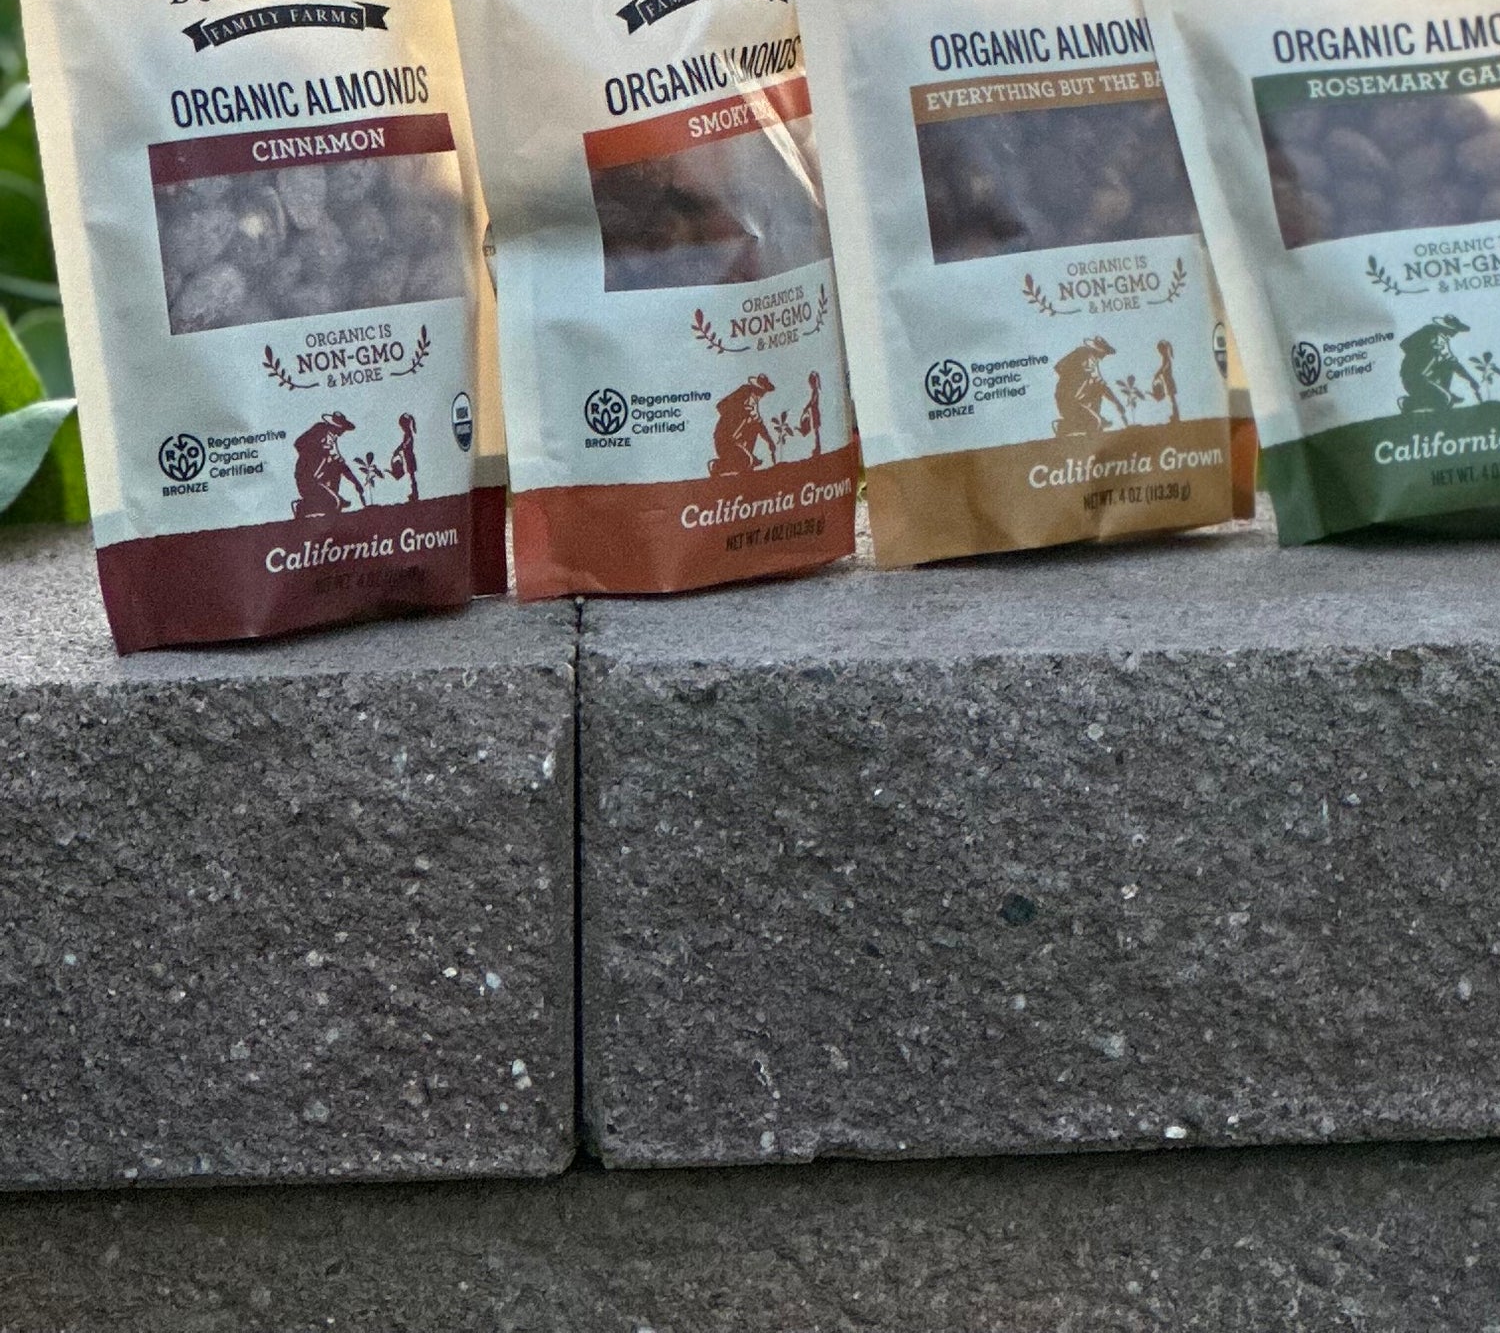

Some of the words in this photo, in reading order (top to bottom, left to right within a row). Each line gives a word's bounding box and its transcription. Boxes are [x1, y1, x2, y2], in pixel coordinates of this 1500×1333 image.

[210, 10, 279, 41] FAMILY
[290, 8, 359, 26] FARMS
[930, 28, 1050, 71] ORGANIC
[1057, 17, 1154, 63] ALMON
[1273, 23, 1415, 64] ORGANIC
[171, 80, 300, 129] ORGANIC
[306, 65, 429, 115] ALMONDS
[605, 53, 727, 116] ORGANIC
[926, 81, 1054, 112] EVERYTHING
[1060, 77, 1094, 97] BUT
[1098, 72, 1140, 93] THE
[1308, 72, 1450, 99] ROSEMARY
[688, 103, 749, 138] SMOKY
[253, 128, 386, 162] CINNAMON
[1414, 237, 1494, 258] ORGANIC
[1067, 258, 1131, 277] ORGANIC
[1134, 256, 1147, 270] IS
[1058, 273, 1160, 301] NON-GMO
[741, 287, 795, 313] ORGANIC
[1101, 296, 1141, 313] MORE
[730, 303, 812, 338] NON-GMO
[305, 326, 375, 348] ORGANIC
[377, 324, 392, 339] IS
[766, 330, 798, 349] MORE
[297, 342, 404, 374] NON-GMO
[971, 354, 1049, 374] Regenerative
[1323, 350, 1368, 367] Organic
[339, 367, 383, 386] MORE
[972, 372, 1021, 388] Organic
[631, 389, 711, 407] Regenerative
[631, 406, 681, 420] Organic
[928, 404, 975, 421] BRONZE
[207, 429, 287, 452] Regenerative
[585, 437, 631, 448] BRONZE
[208, 447, 258, 465] Organic
[1029, 451, 1153, 489] California
[1159, 445, 1223, 472] Grown
[162, 482, 209, 497] BRONZE
[681, 495, 795, 529] California
[800, 476, 852, 507] Grown
[265, 539, 394, 573] California
[400, 528, 458, 554] Grown
